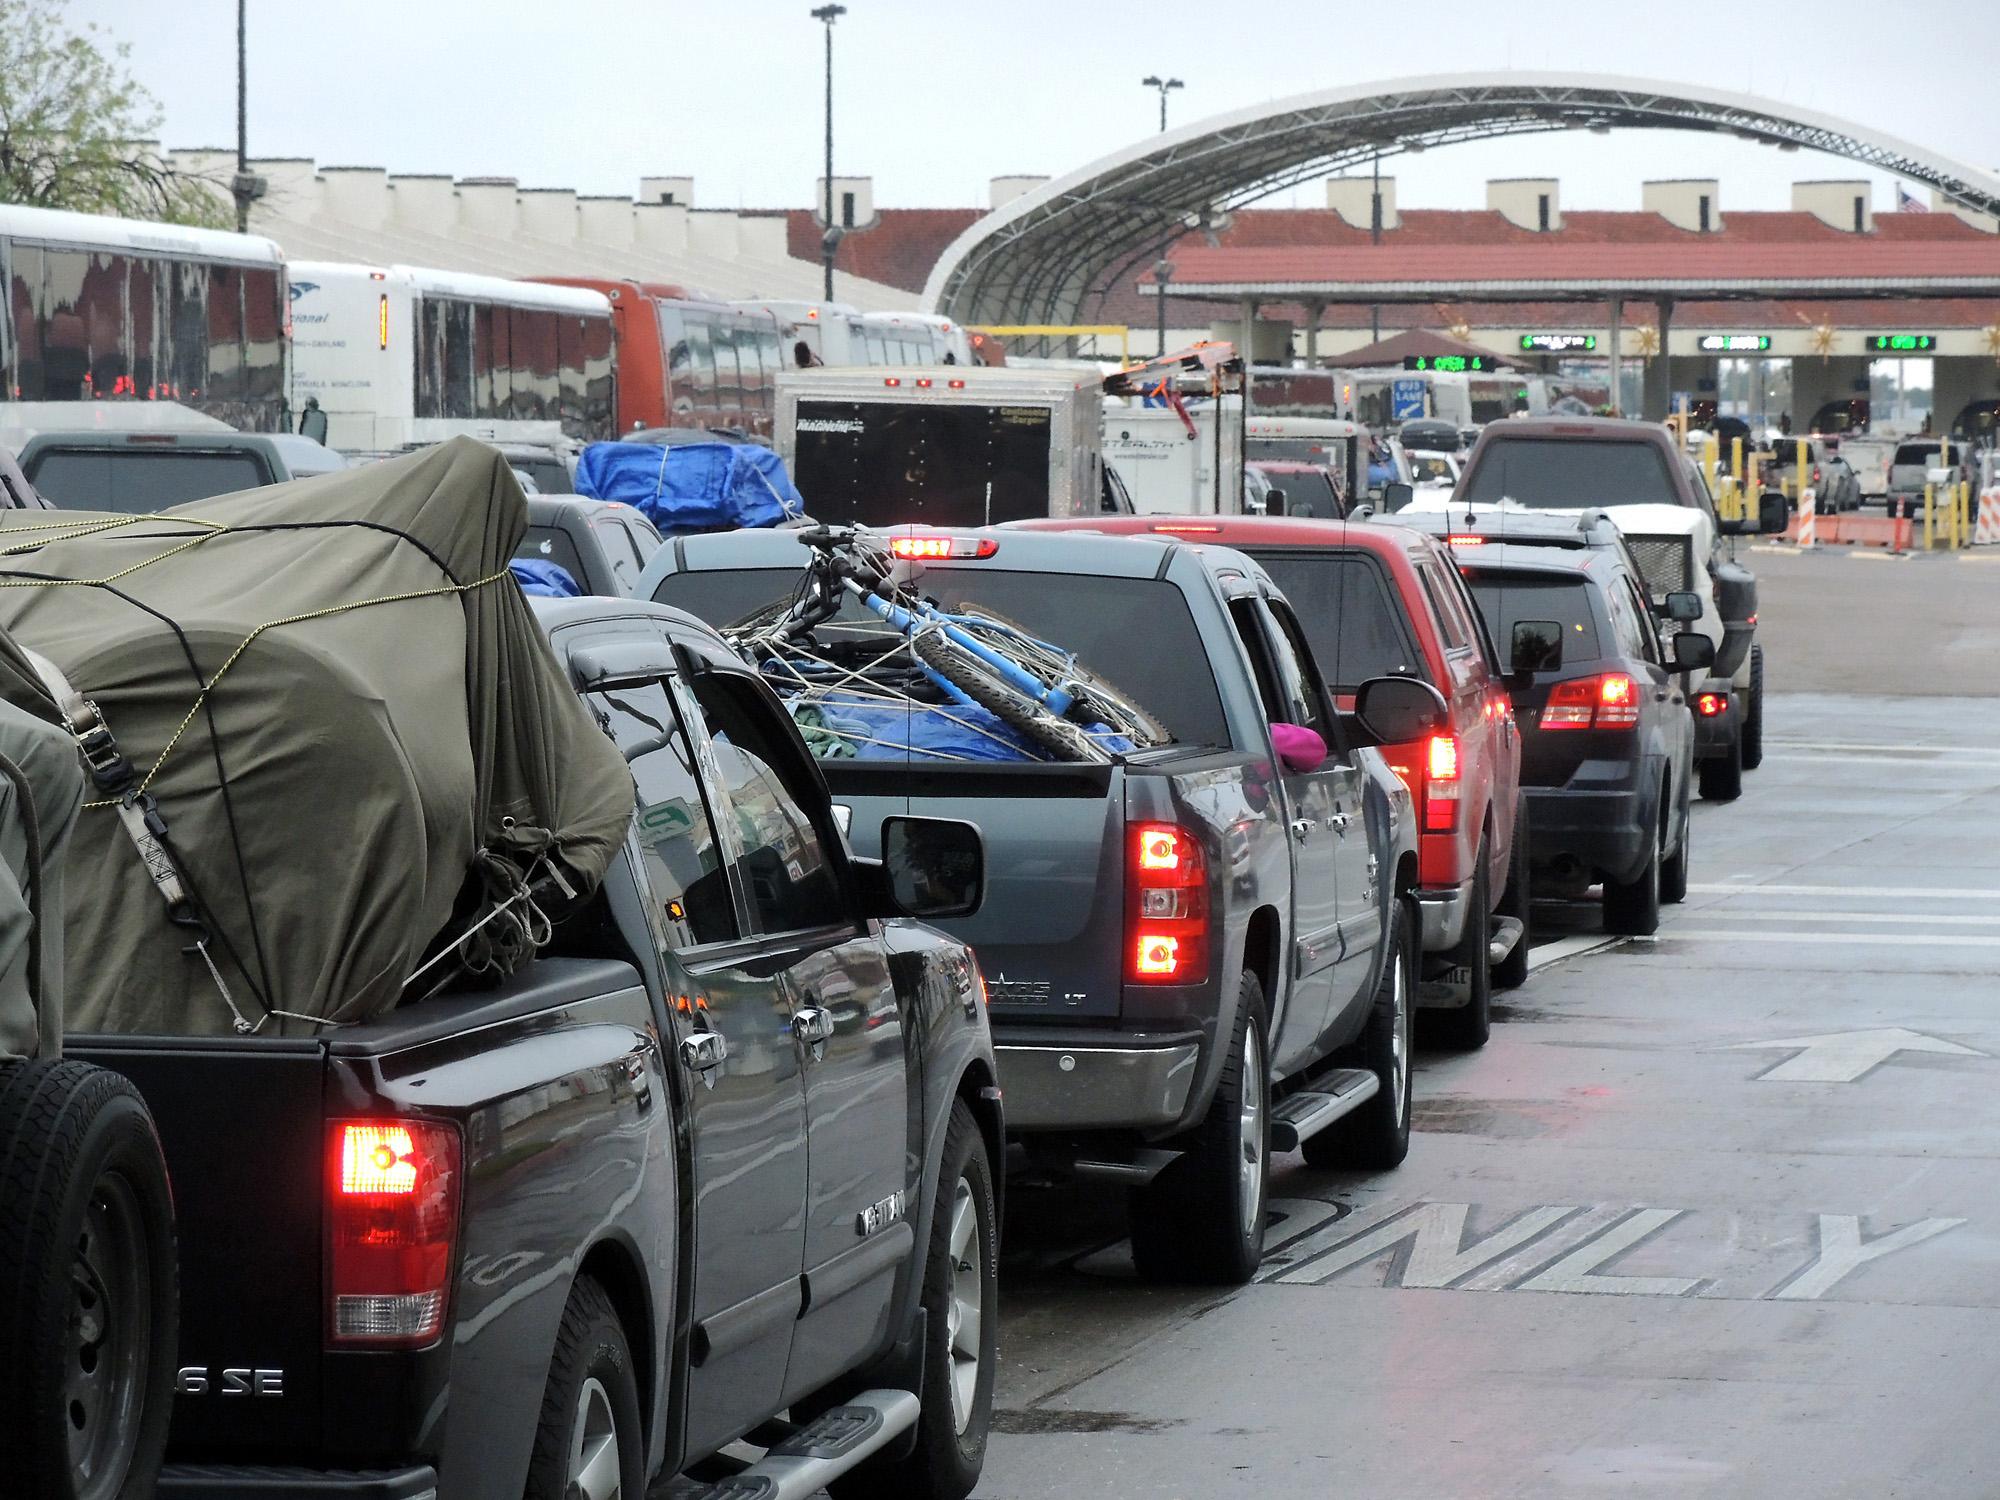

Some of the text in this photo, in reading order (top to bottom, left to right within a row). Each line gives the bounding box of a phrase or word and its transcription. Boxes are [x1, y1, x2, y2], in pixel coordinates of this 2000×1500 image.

[1434, 356, 1466, 371] OPEN
[1400, 381, 1420, 390] BUS
[1395, 392, 1423, 401] LANE
[797, 419, 849, 433] MAGNUM
[1101, 440, 1173, 448] STEALTH
[221, 1368, 284, 1397] SE
